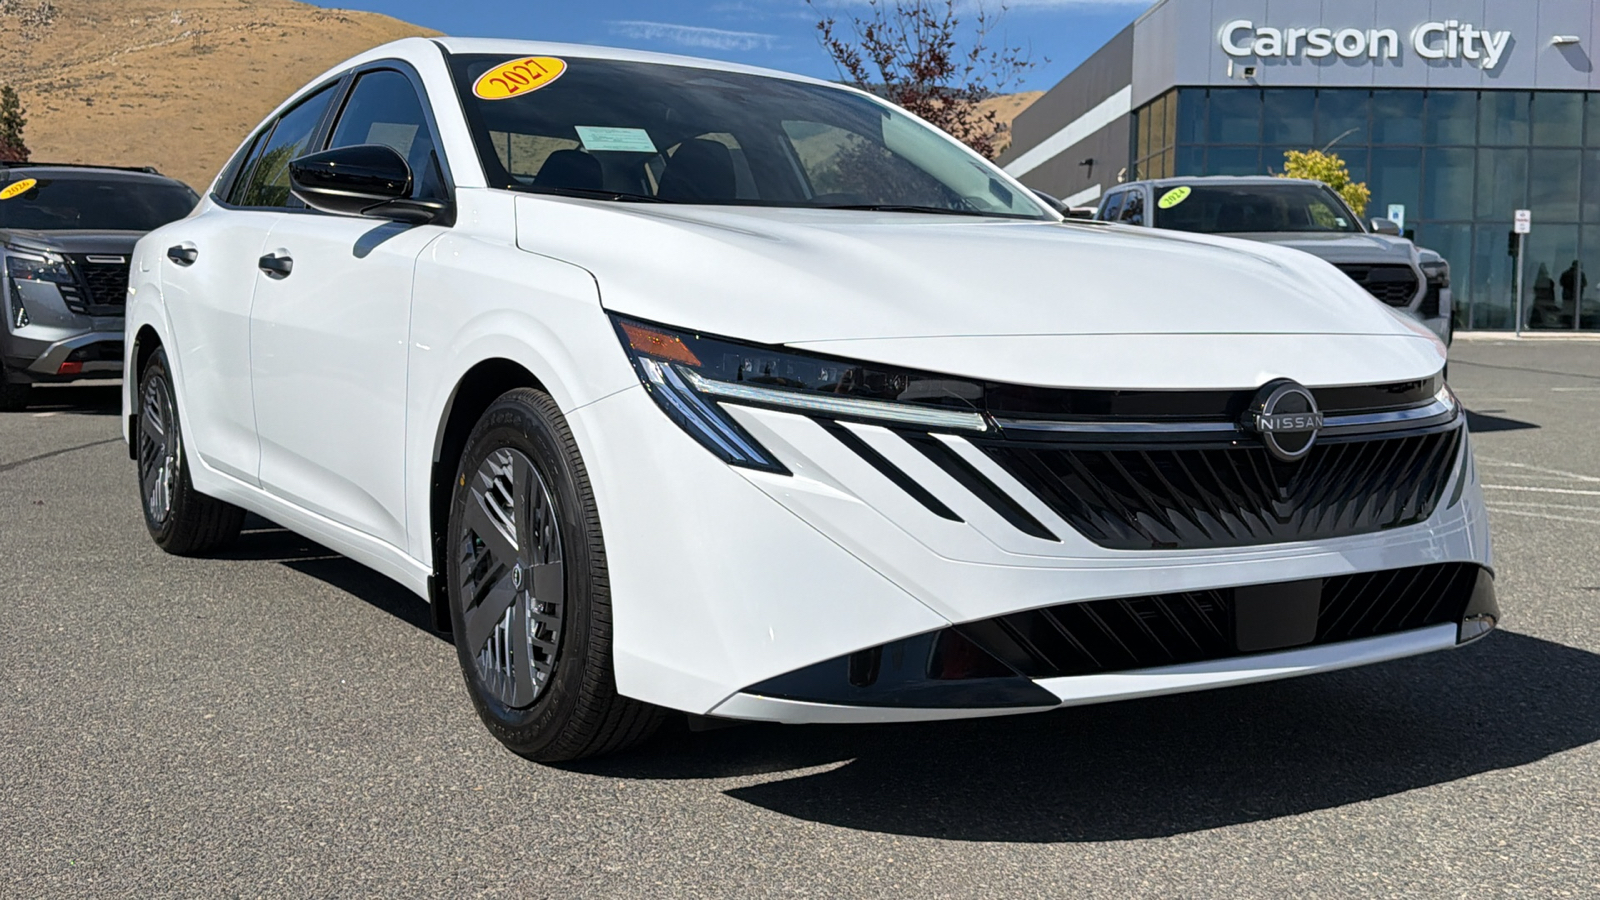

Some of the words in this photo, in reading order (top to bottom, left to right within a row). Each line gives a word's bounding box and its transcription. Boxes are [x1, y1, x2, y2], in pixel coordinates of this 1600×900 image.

[1219, 19, 1398, 58] Carson
[1412, 19, 1512, 69] City
[489, 59, 548, 94] 2027
[1260, 416, 1323, 430] NISSAN
